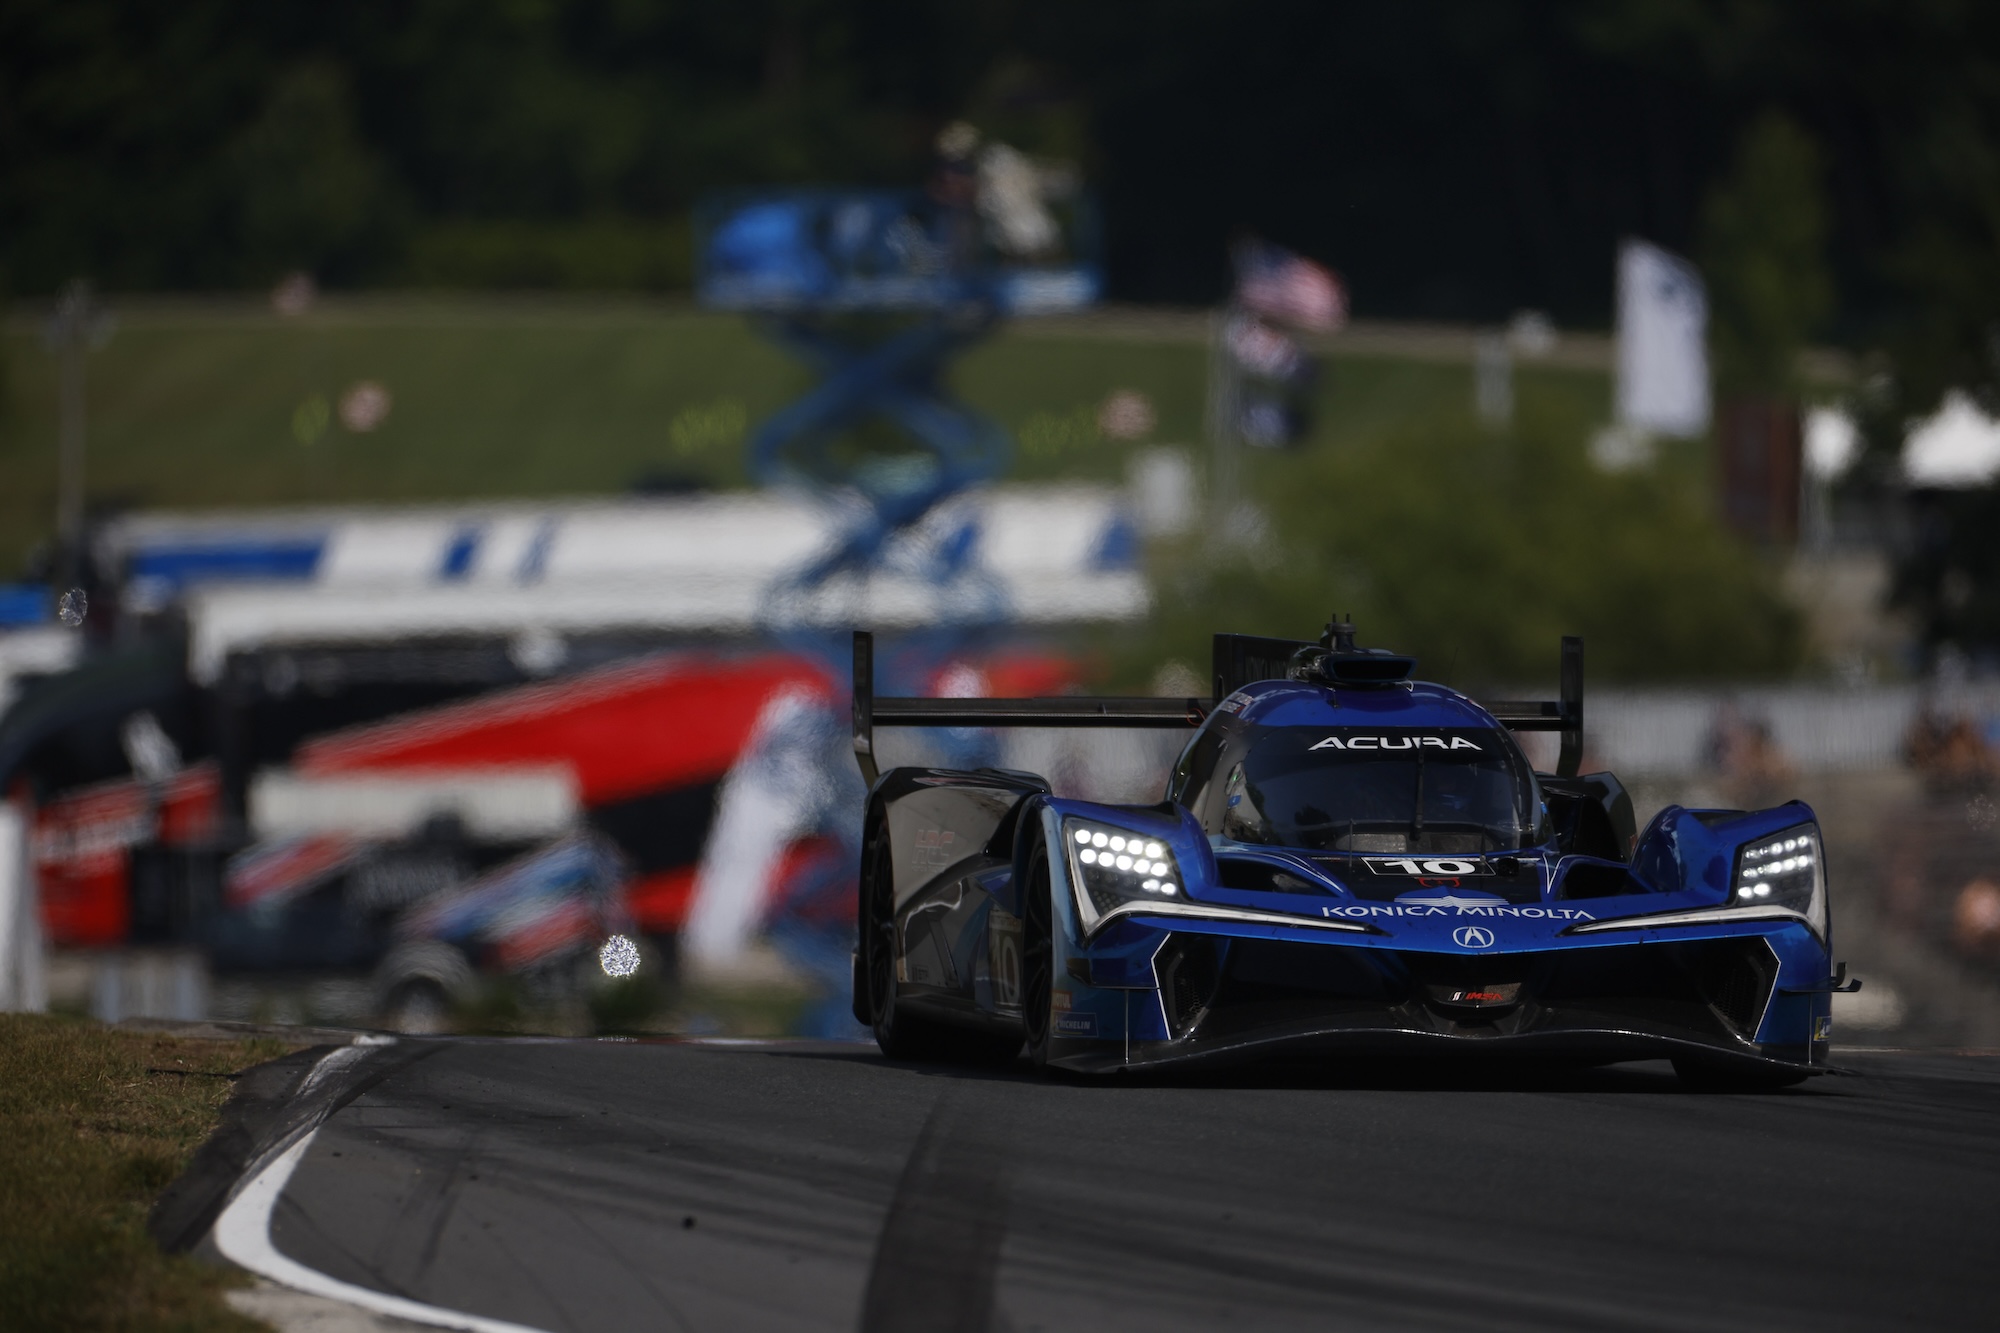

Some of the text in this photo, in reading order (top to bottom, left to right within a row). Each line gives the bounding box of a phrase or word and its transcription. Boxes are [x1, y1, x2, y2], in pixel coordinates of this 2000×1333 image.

[1308, 736, 1483, 751] ACURA
[1383, 860, 1476, 875] 10
[1321, 906, 1597, 921] KONICA MINOLTA
[991, 932, 1021, 1004] 10
[1465, 991, 1503, 1001] IMSA
[1059, 1019, 1091, 1030] MICHELIN
